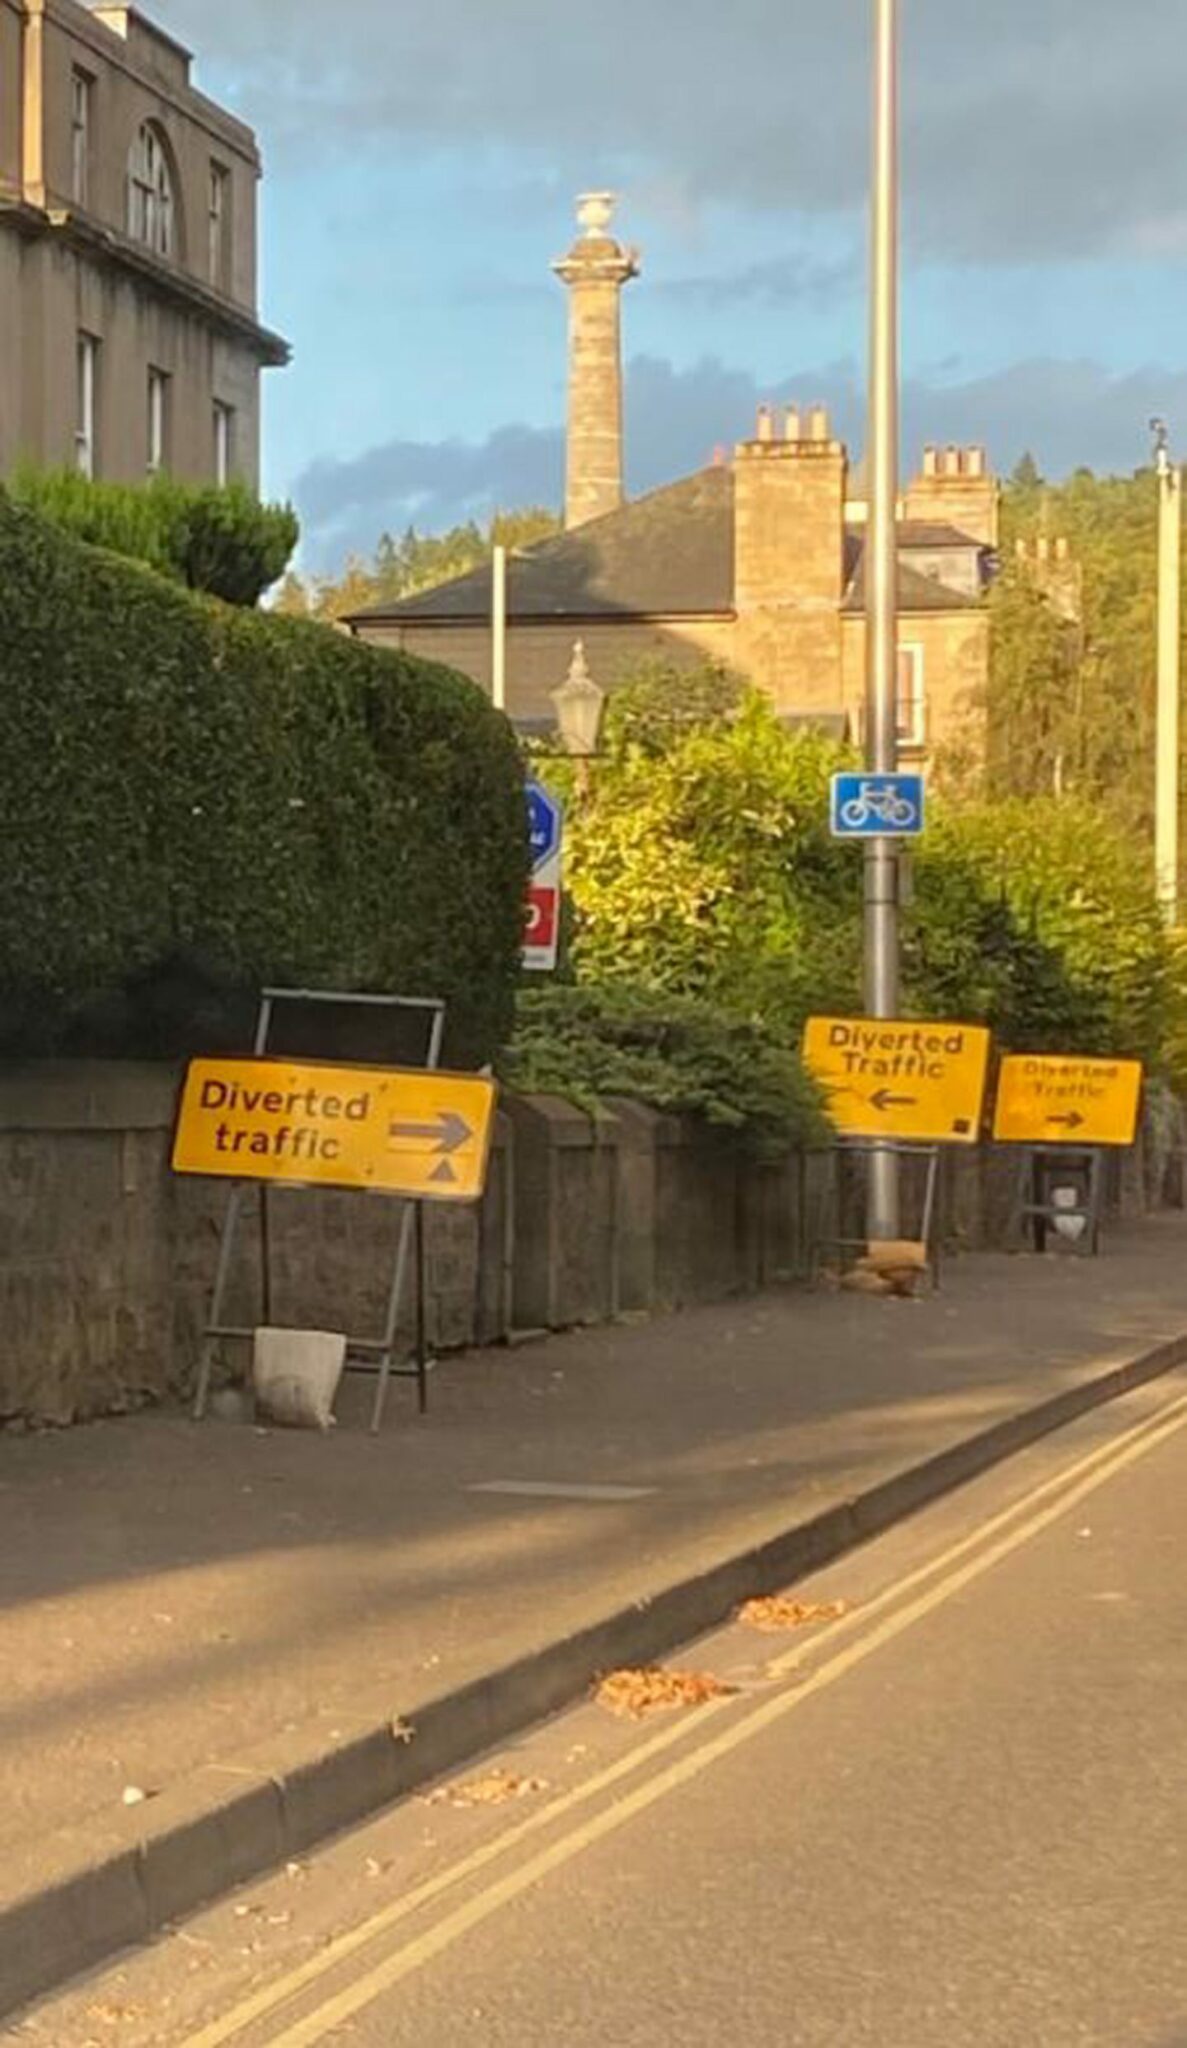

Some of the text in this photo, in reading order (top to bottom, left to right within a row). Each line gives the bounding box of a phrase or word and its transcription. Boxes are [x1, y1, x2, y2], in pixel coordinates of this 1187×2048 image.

[829, 1025, 964, 1053] Diverted
[841, 1051, 945, 1079] Traffic
[201, 1079, 371, 1121] Diverted
[215, 1123, 340, 1160] traffic
